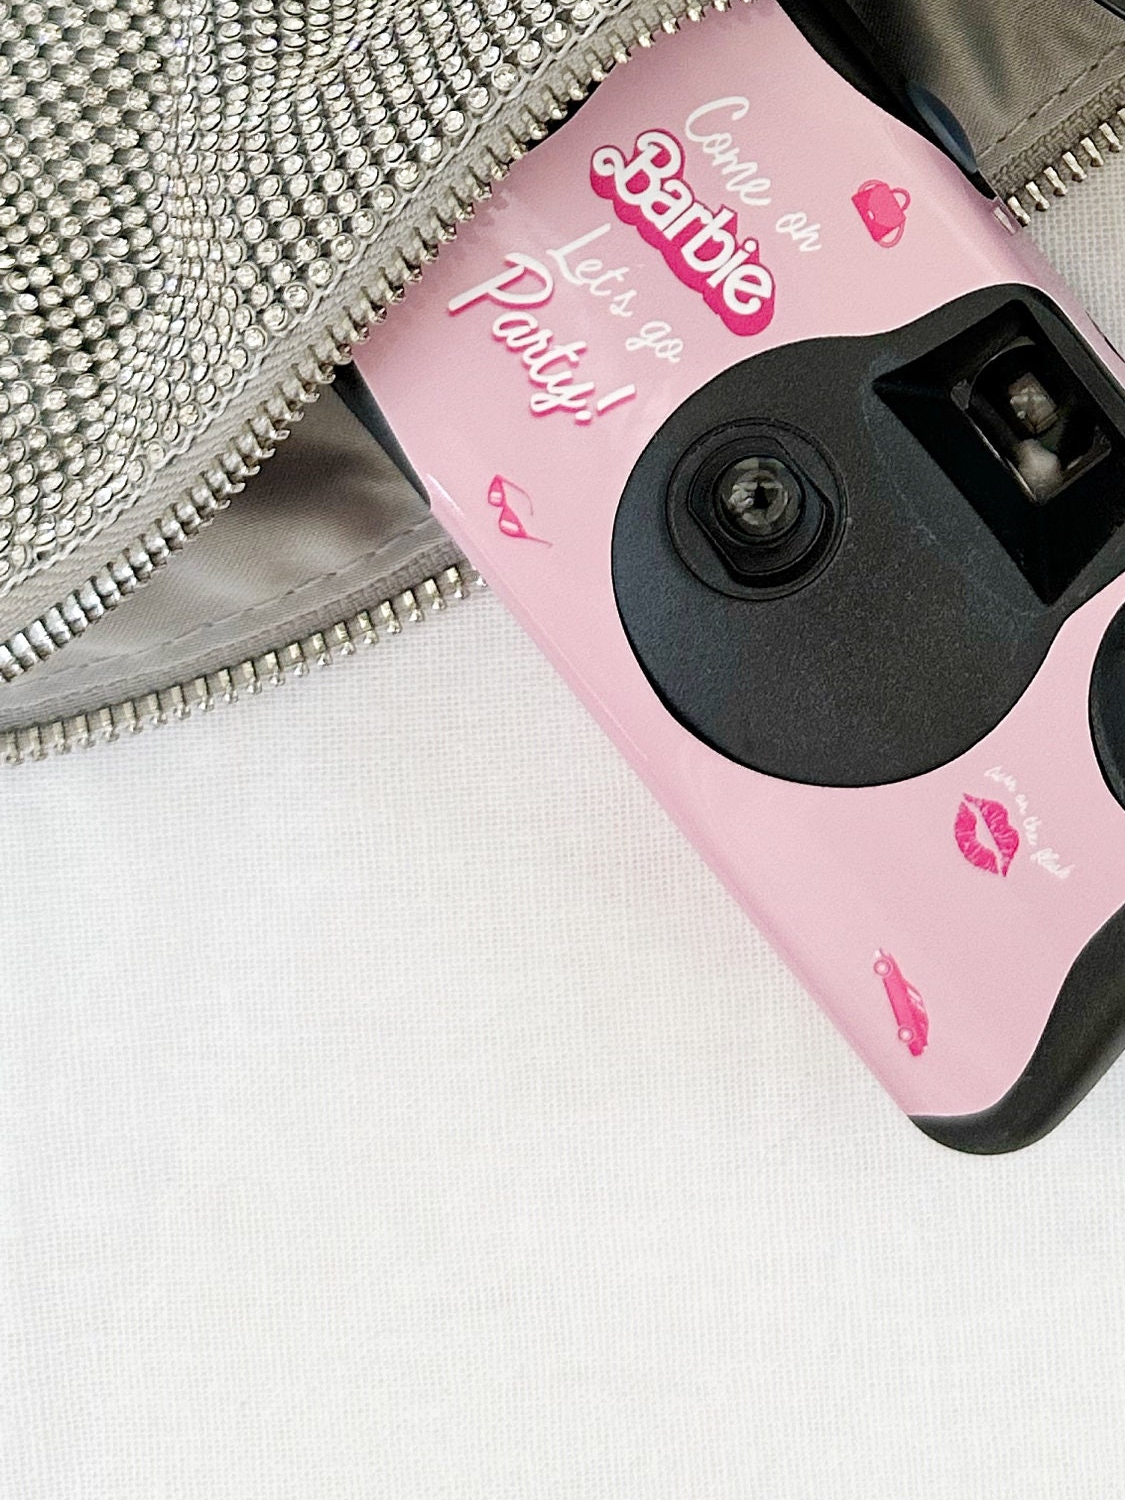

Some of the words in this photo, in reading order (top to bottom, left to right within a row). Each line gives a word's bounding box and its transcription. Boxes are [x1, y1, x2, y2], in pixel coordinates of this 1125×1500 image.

[590, 129, 776, 332] Barbie
[685, 95, 773, 206] Come
[775, 210, 823, 253] on
[448, 251, 638, 426] Party!
[625, 320, 684, 364] go
